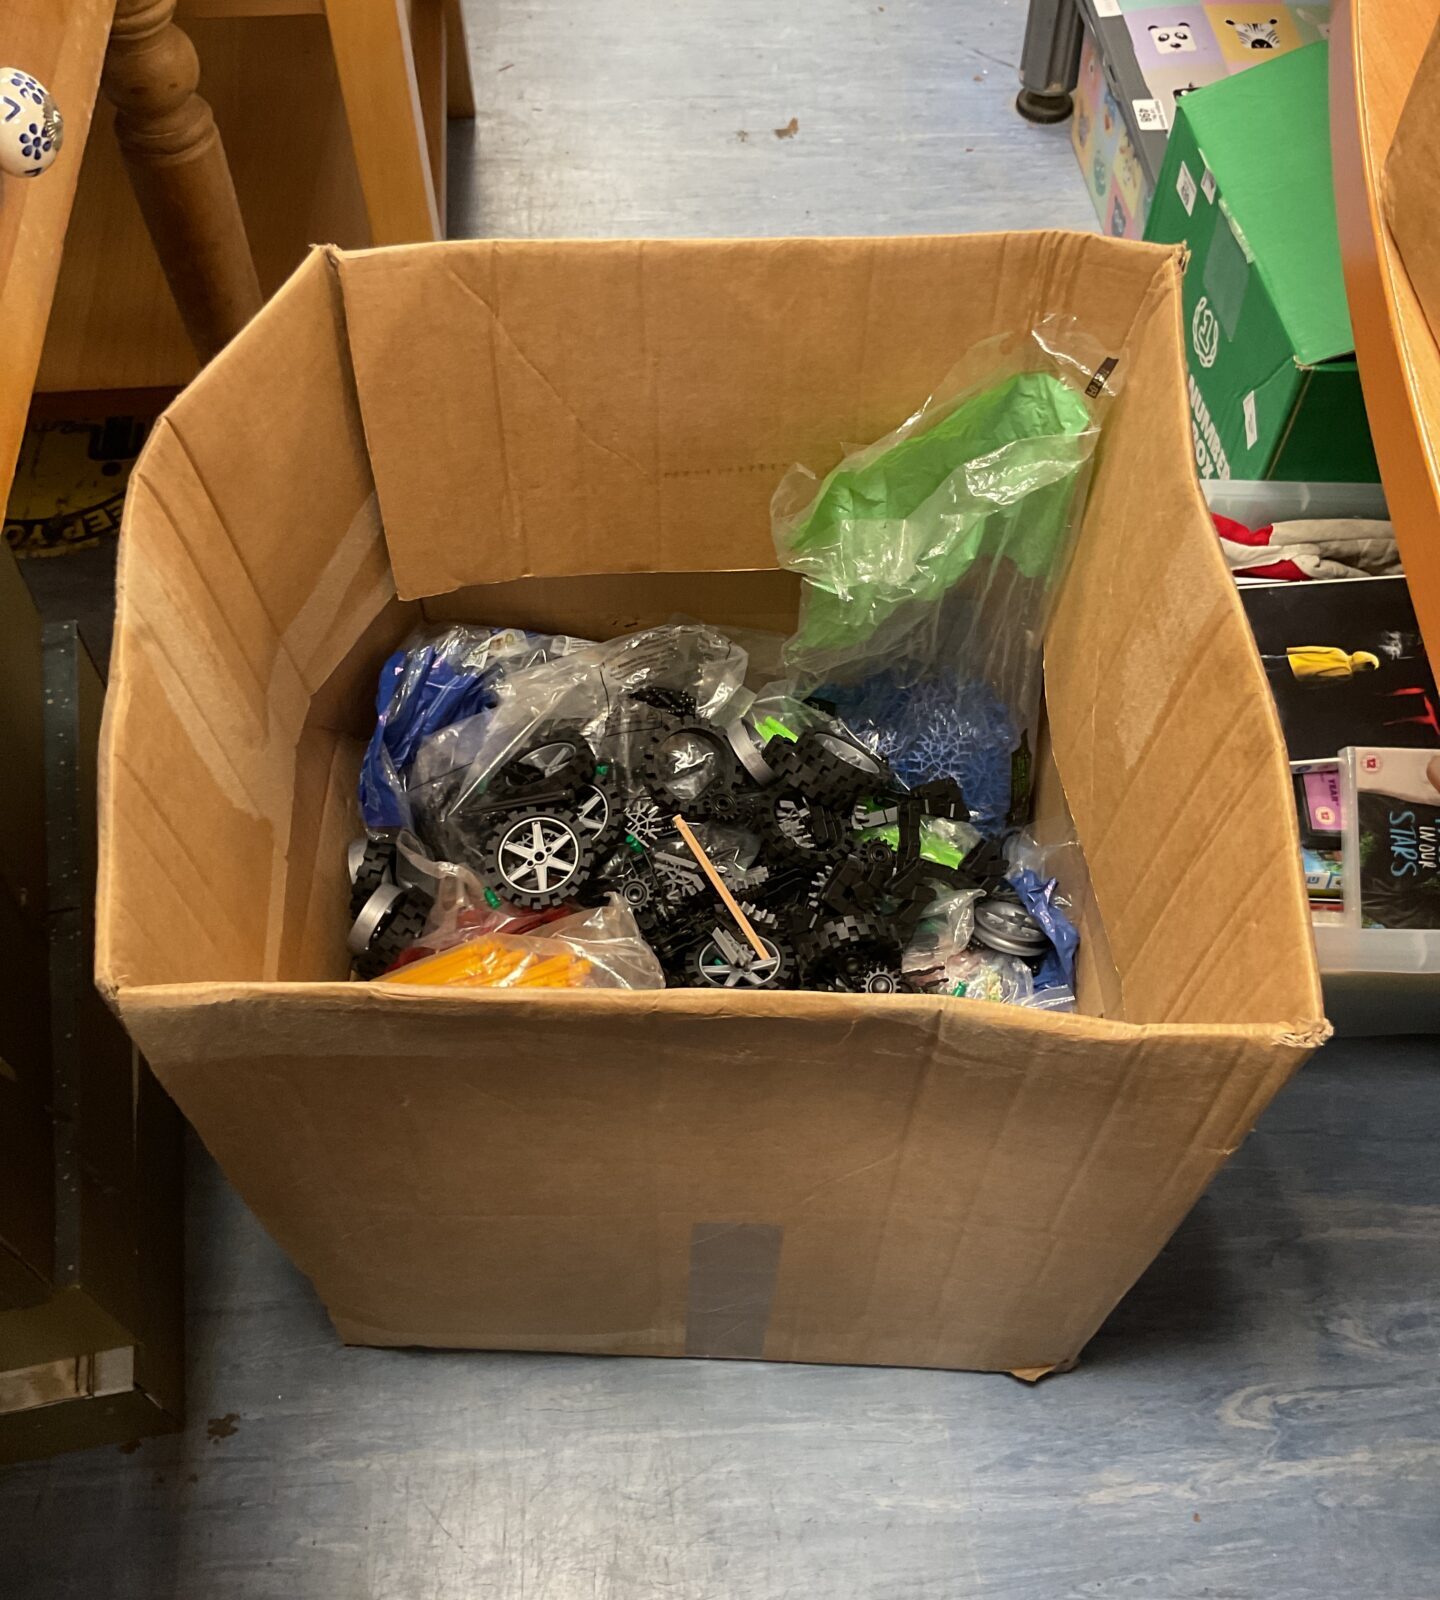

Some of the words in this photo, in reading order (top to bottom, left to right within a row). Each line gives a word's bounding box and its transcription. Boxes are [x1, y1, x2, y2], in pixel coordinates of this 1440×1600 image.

[1188, 374, 1231, 480] NUMBER
[1389, 811, 1418, 877] STARS
[1418, 826, 1437, 842] IN
[1418, 844, 1437, 868] OUR
